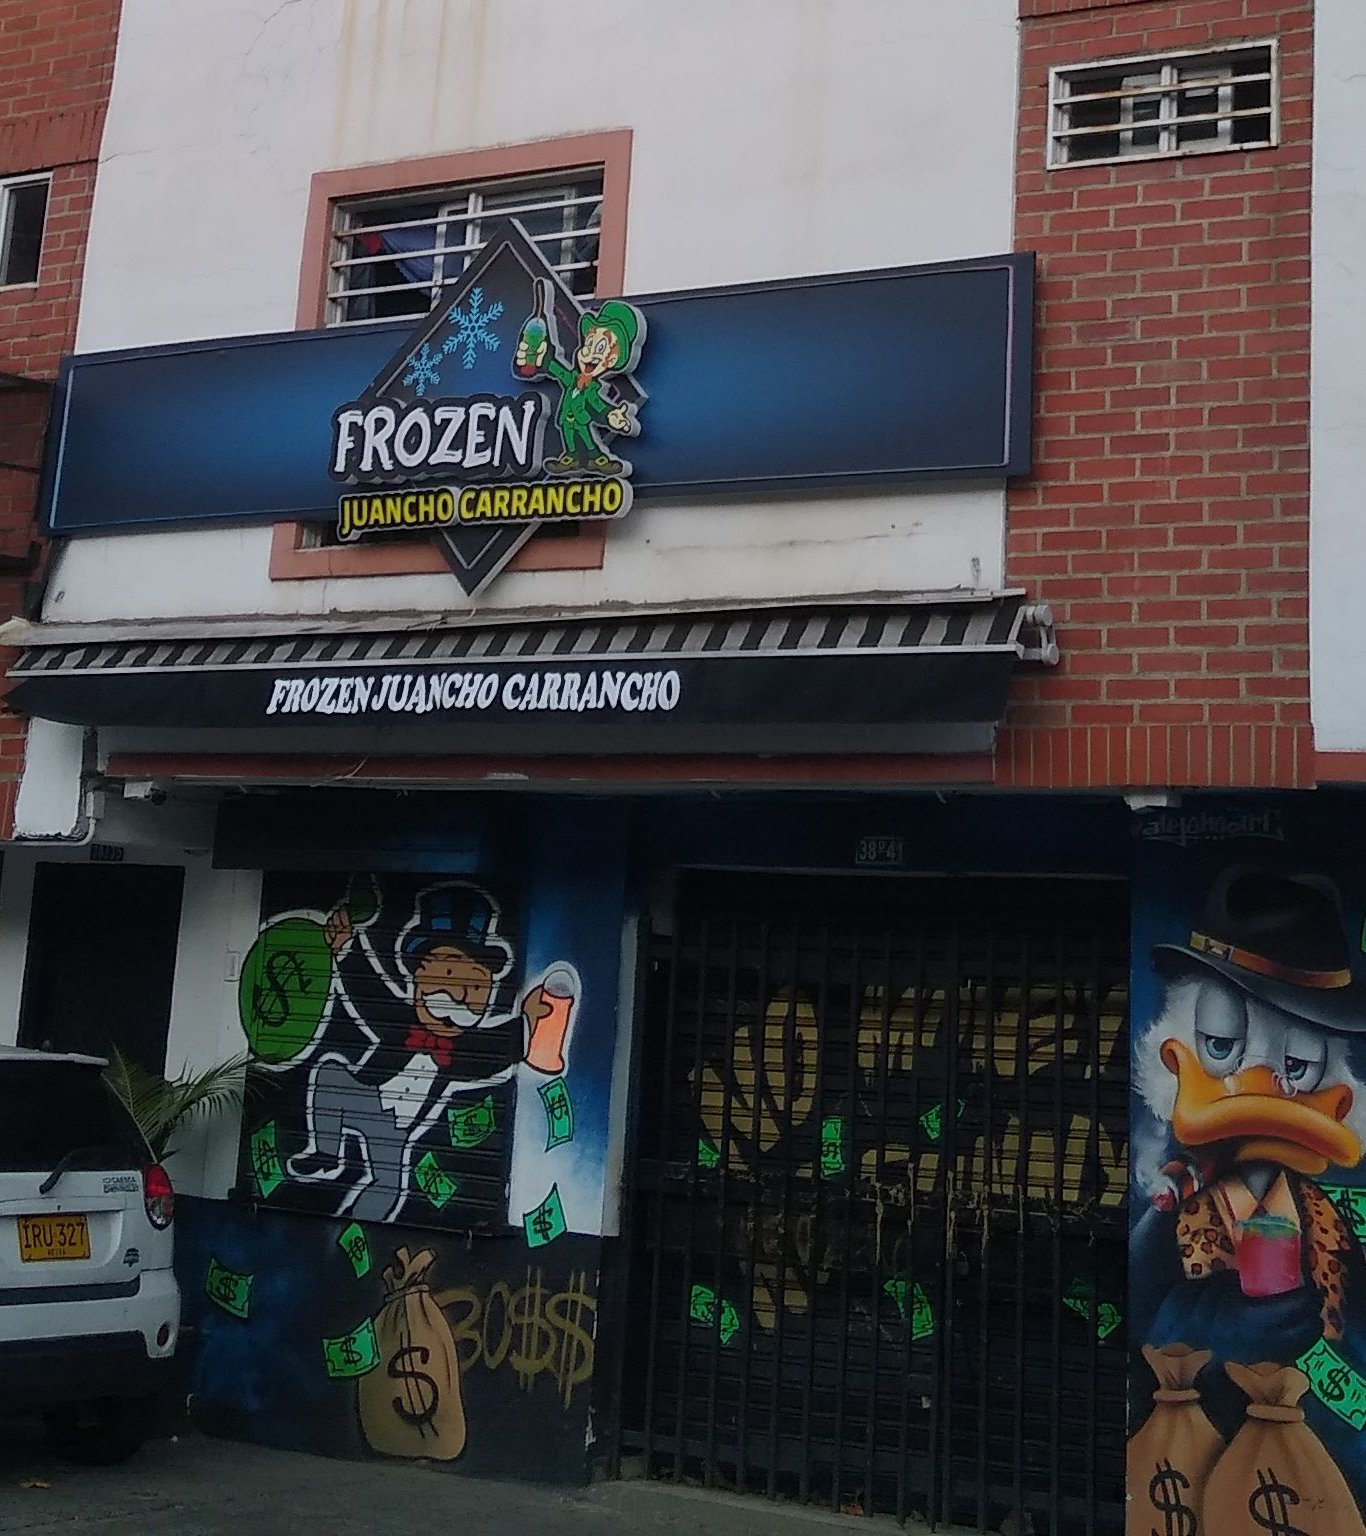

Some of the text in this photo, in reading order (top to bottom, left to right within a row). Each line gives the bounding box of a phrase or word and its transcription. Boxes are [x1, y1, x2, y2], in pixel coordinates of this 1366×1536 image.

[334, 400, 535, 472] FROZEN
[341, 479, 623, 534] JUANCHO CARRANCHO
[266, 670, 681, 714] FROZEN JUANCHO CARRANCHO
[22, 1221, 86, 1249] IRU 327
